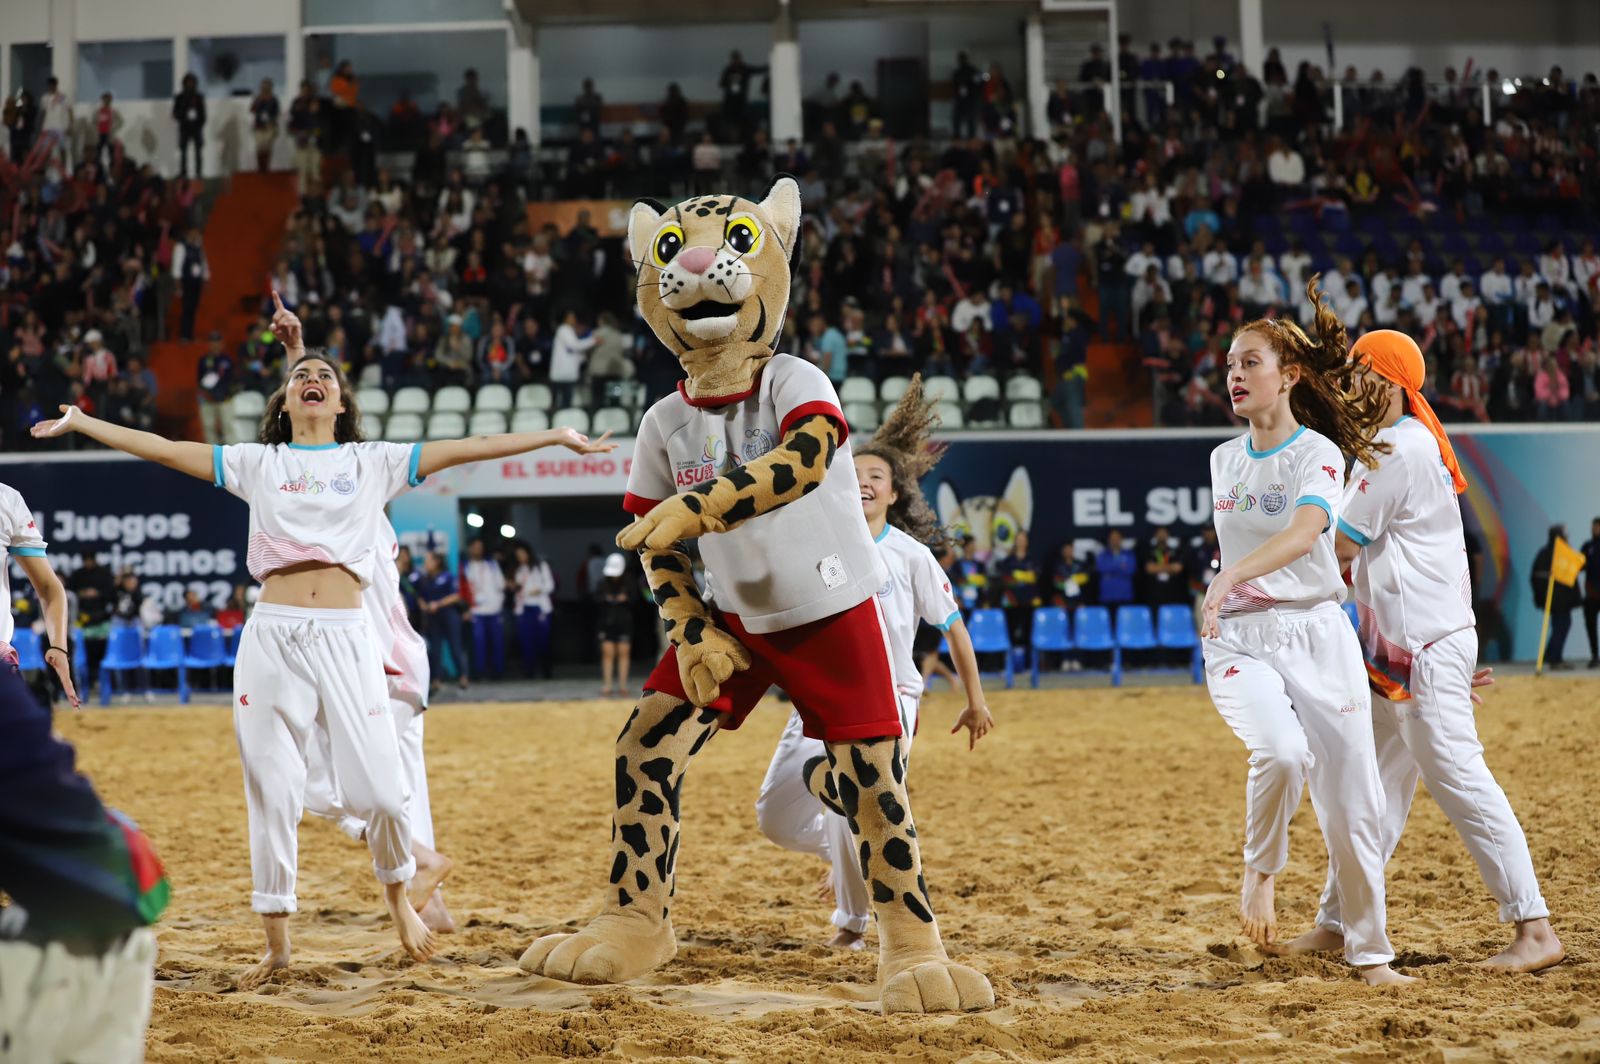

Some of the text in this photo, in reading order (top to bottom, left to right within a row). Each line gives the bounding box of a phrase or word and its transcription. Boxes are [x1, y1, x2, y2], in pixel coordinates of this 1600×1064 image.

[503, 462, 529, 478] EL
[536, 456, 616, 478] SUEÑO
[676, 466, 705, 487] ASU
[1073, 488, 1134, 526] EL
[54, 511, 190, 547] Juegos
